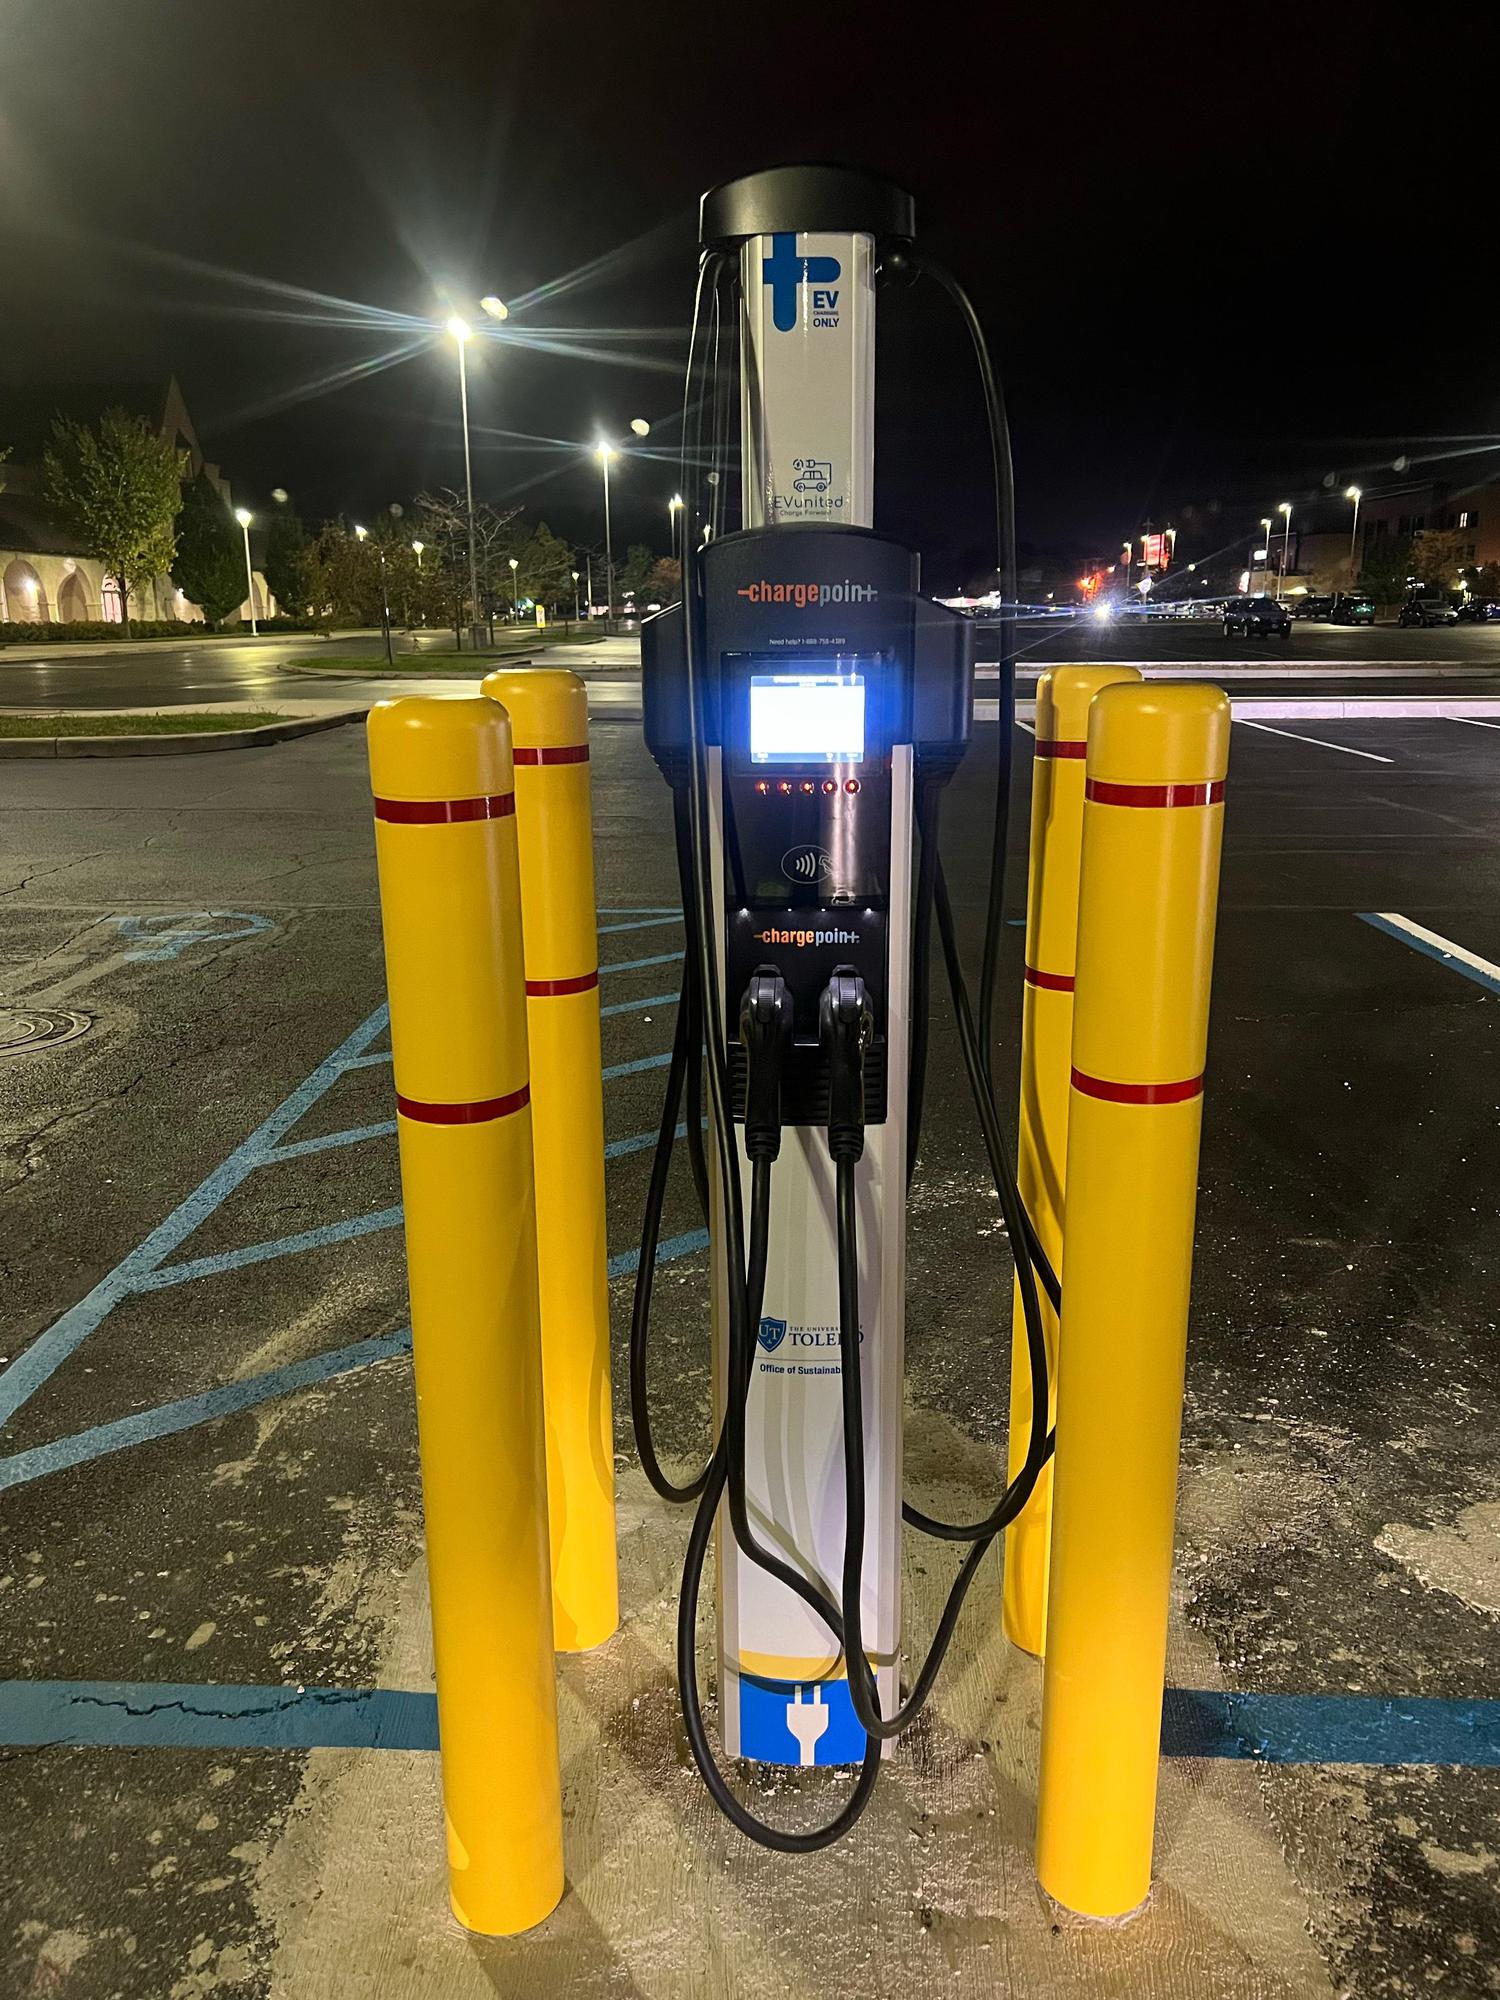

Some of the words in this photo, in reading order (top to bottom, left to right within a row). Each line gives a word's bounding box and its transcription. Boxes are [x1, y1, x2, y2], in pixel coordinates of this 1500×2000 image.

[813, 290, 840, 308] EV
[813, 318, 840, 327] ONLY
[774, 495, 843, 508] EVunited
[760, 1324, 780, 1340] UT
[789, 1331, 864, 1346] TOLE
[760, 1363, 785, 1374] Office
[787, 1366, 796, 1374] of
[798, 1366, 841, 1375] Sustainab
